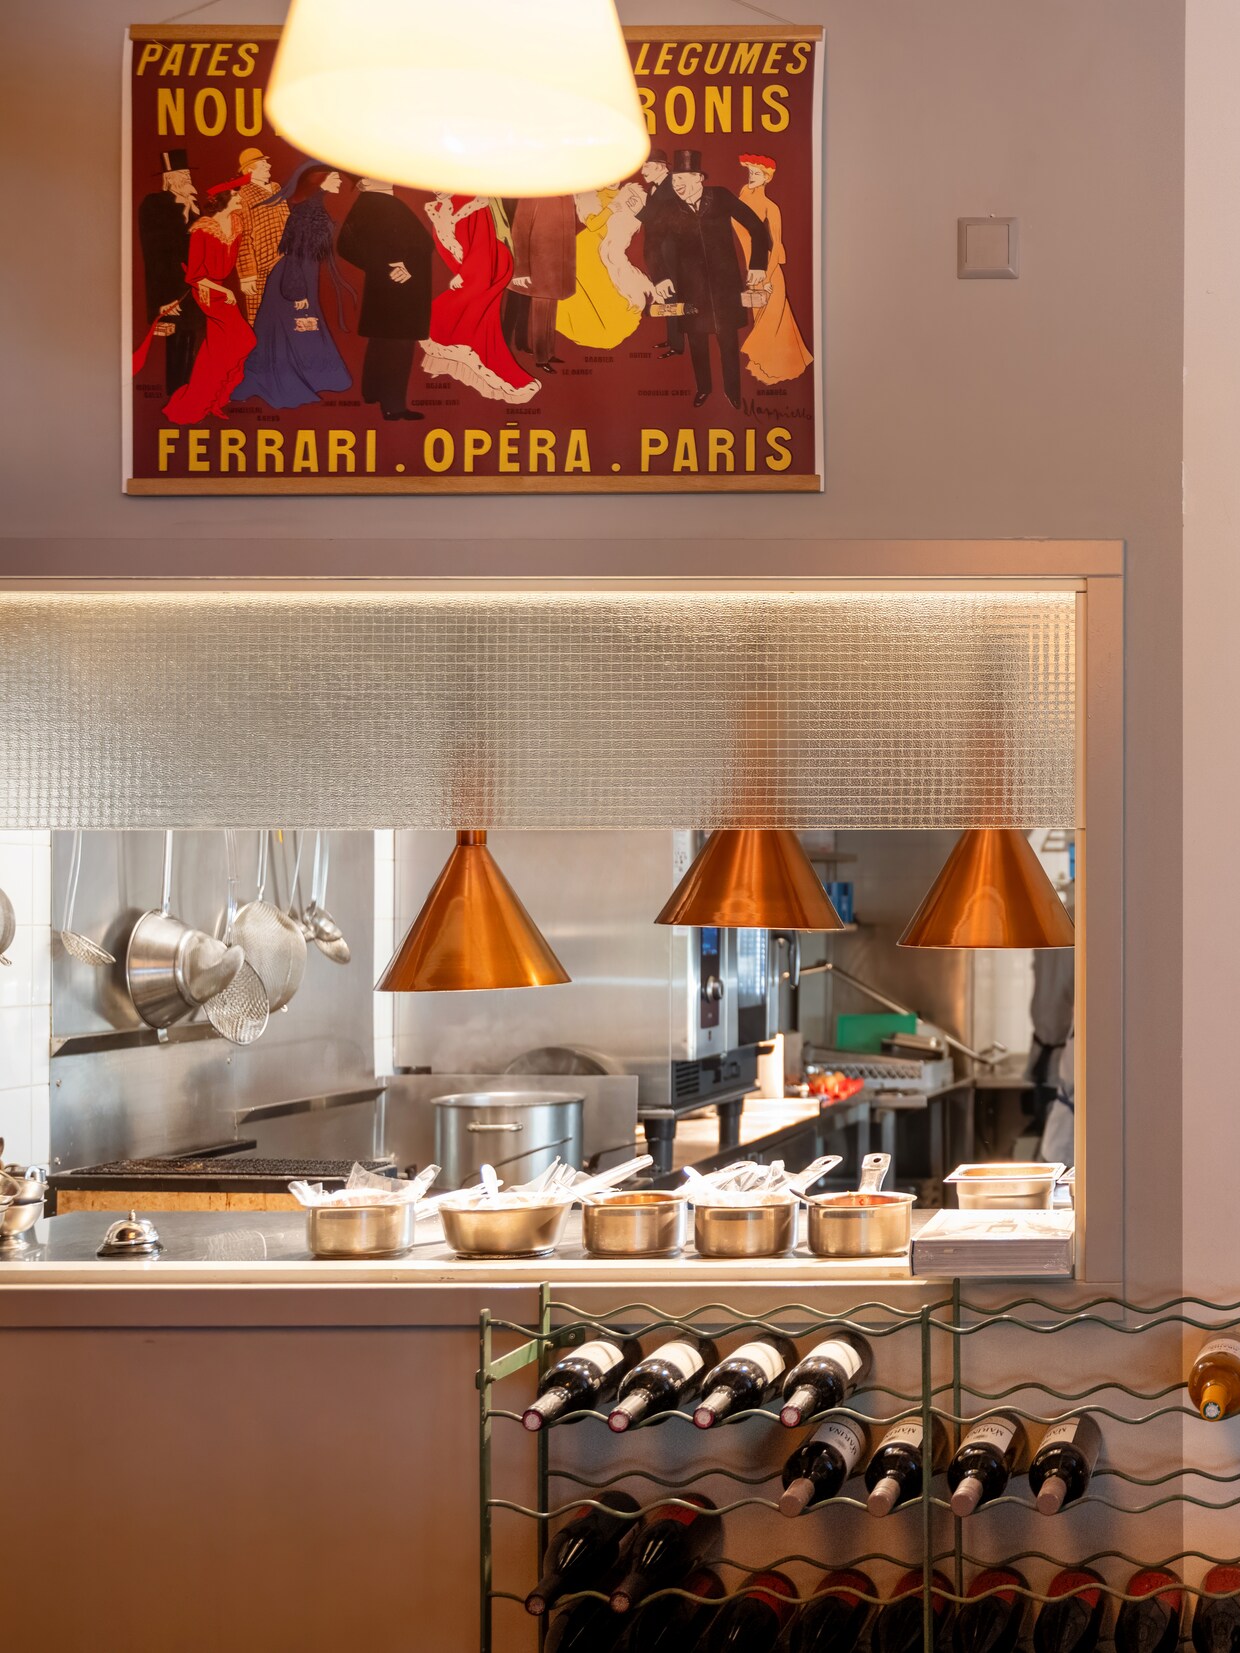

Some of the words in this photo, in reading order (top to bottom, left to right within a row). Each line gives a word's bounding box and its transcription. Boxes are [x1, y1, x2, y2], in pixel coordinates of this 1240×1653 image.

[136, 43, 259, 77] PATES
[634, 42, 811, 76] LEGUMES
[158, 87, 283, 137] NOU
[158, 429, 376, 472] FERRARI
[641, 427, 792, 472] PARIS
